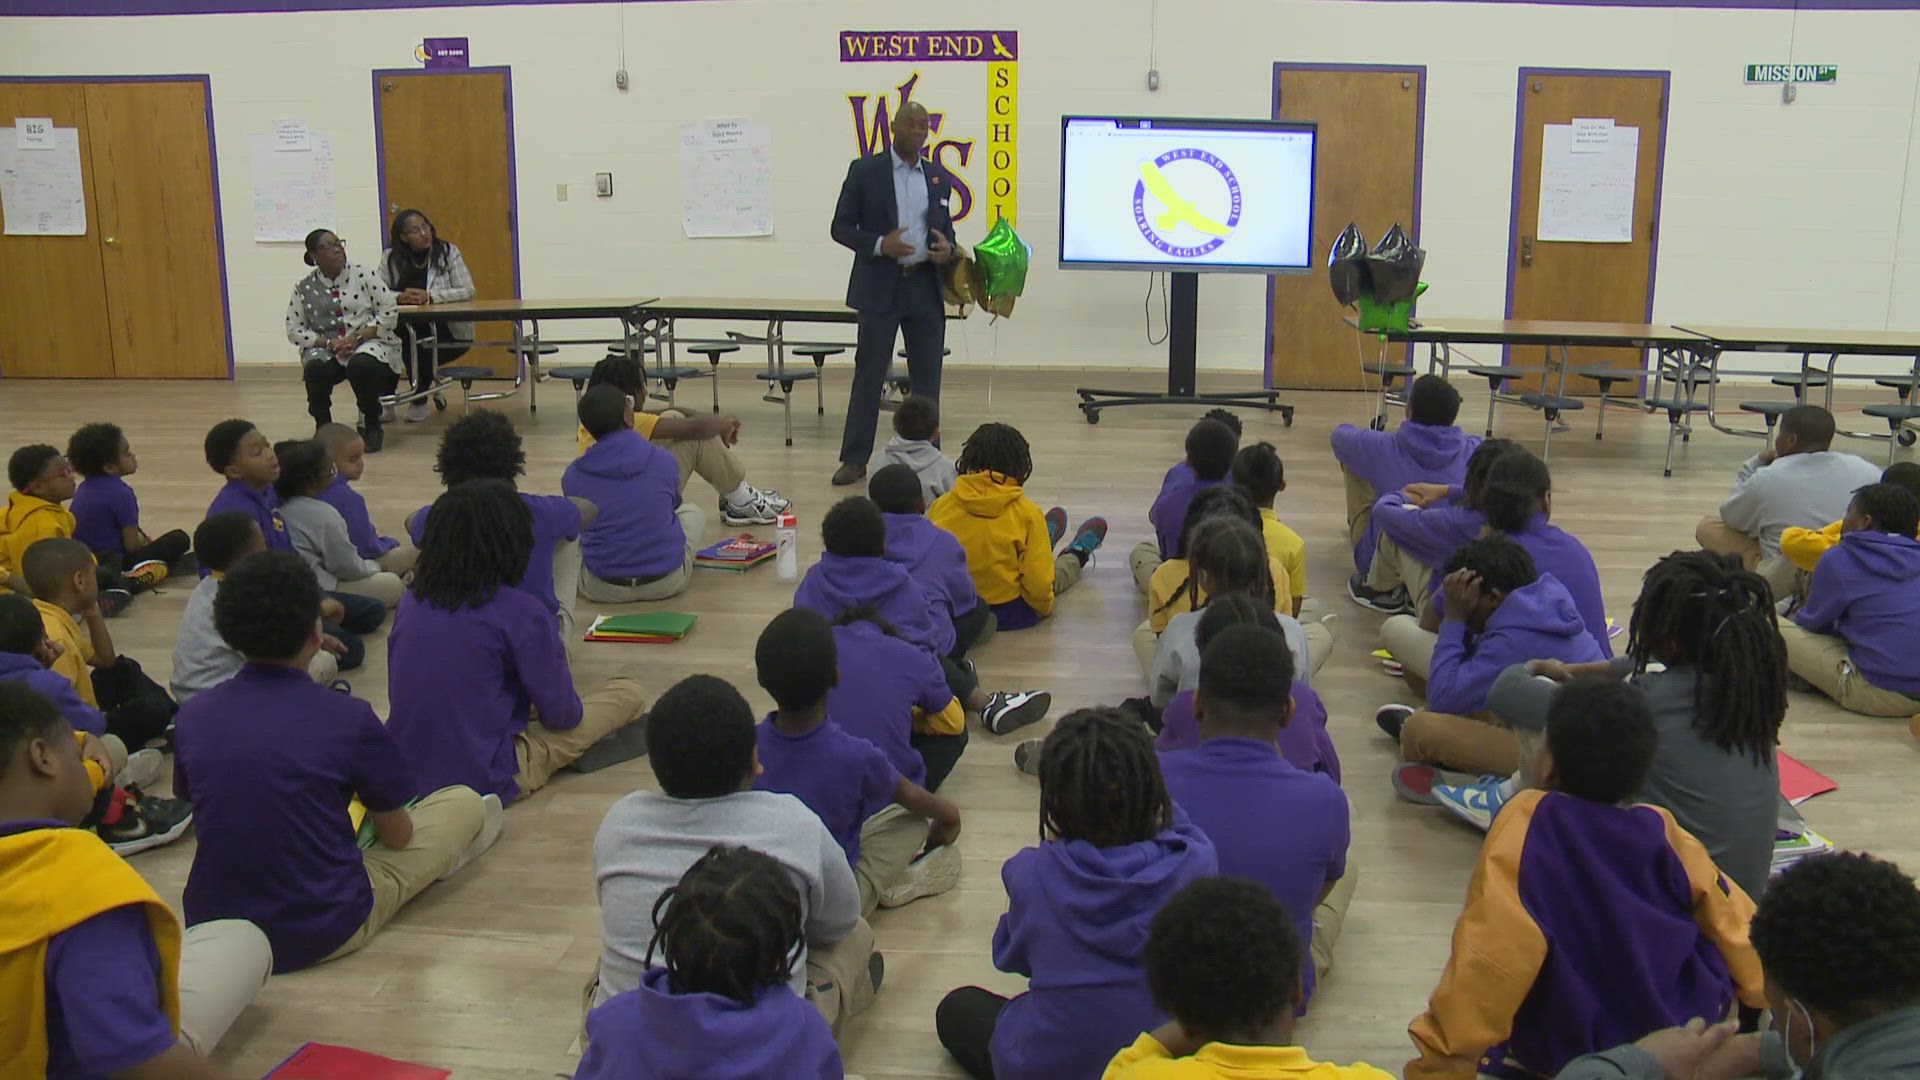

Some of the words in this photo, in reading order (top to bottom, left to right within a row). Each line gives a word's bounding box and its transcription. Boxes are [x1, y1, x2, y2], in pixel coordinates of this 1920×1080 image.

[845, 35, 919, 57] WEST
[927, 35, 984, 57] END
[1754, 65, 1817, 81] MISSION
[26, 124, 44, 134] BIG
[993, 68, 1011, 222] SCHOOL
[1161, 150, 1195, 162] WEST
[1200, 151, 1223, 169] END
[1225, 170, 1240, 220] SCHOOL
[1135, 198, 1165, 248] SOARING
[1167, 243, 1215, 257] EAGLES
